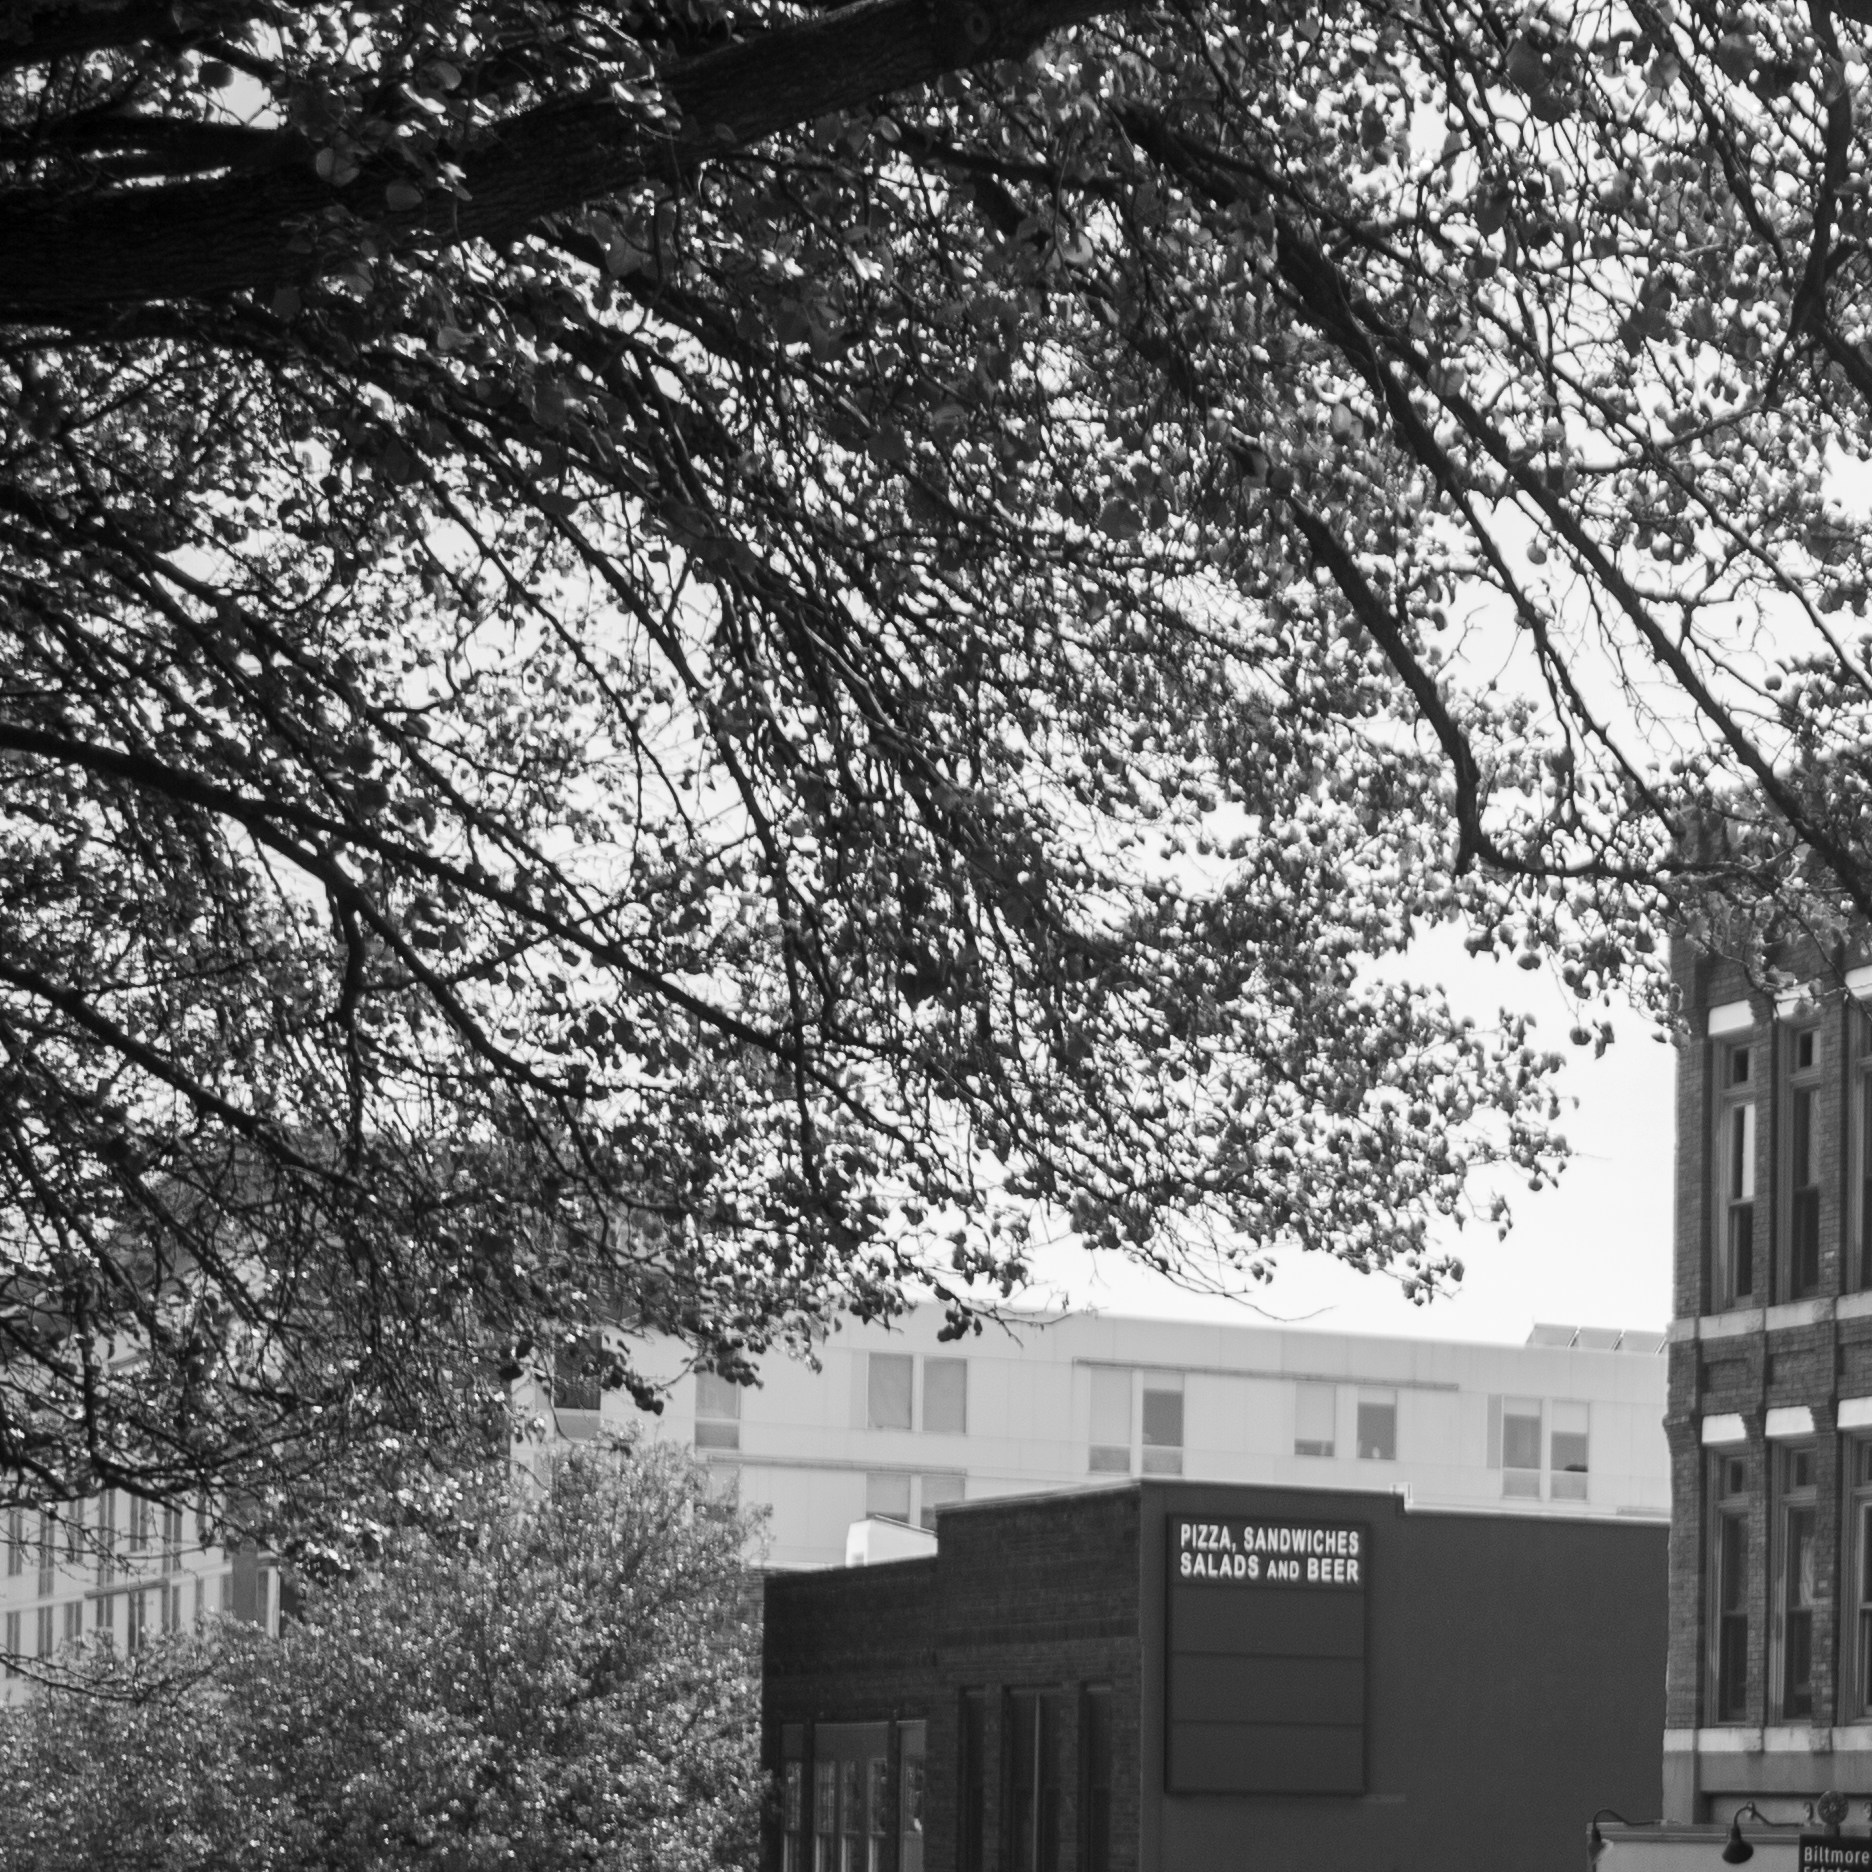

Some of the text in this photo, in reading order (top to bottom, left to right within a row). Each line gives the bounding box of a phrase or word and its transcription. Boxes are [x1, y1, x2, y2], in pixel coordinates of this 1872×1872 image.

[1180, 1523, 1359, 1556] PIZZA, SANDWICHES
[1180, 1551, 1359, 1584] SALADS AND BEER
[1804, 1846, 1870, 1865] Biltmore
